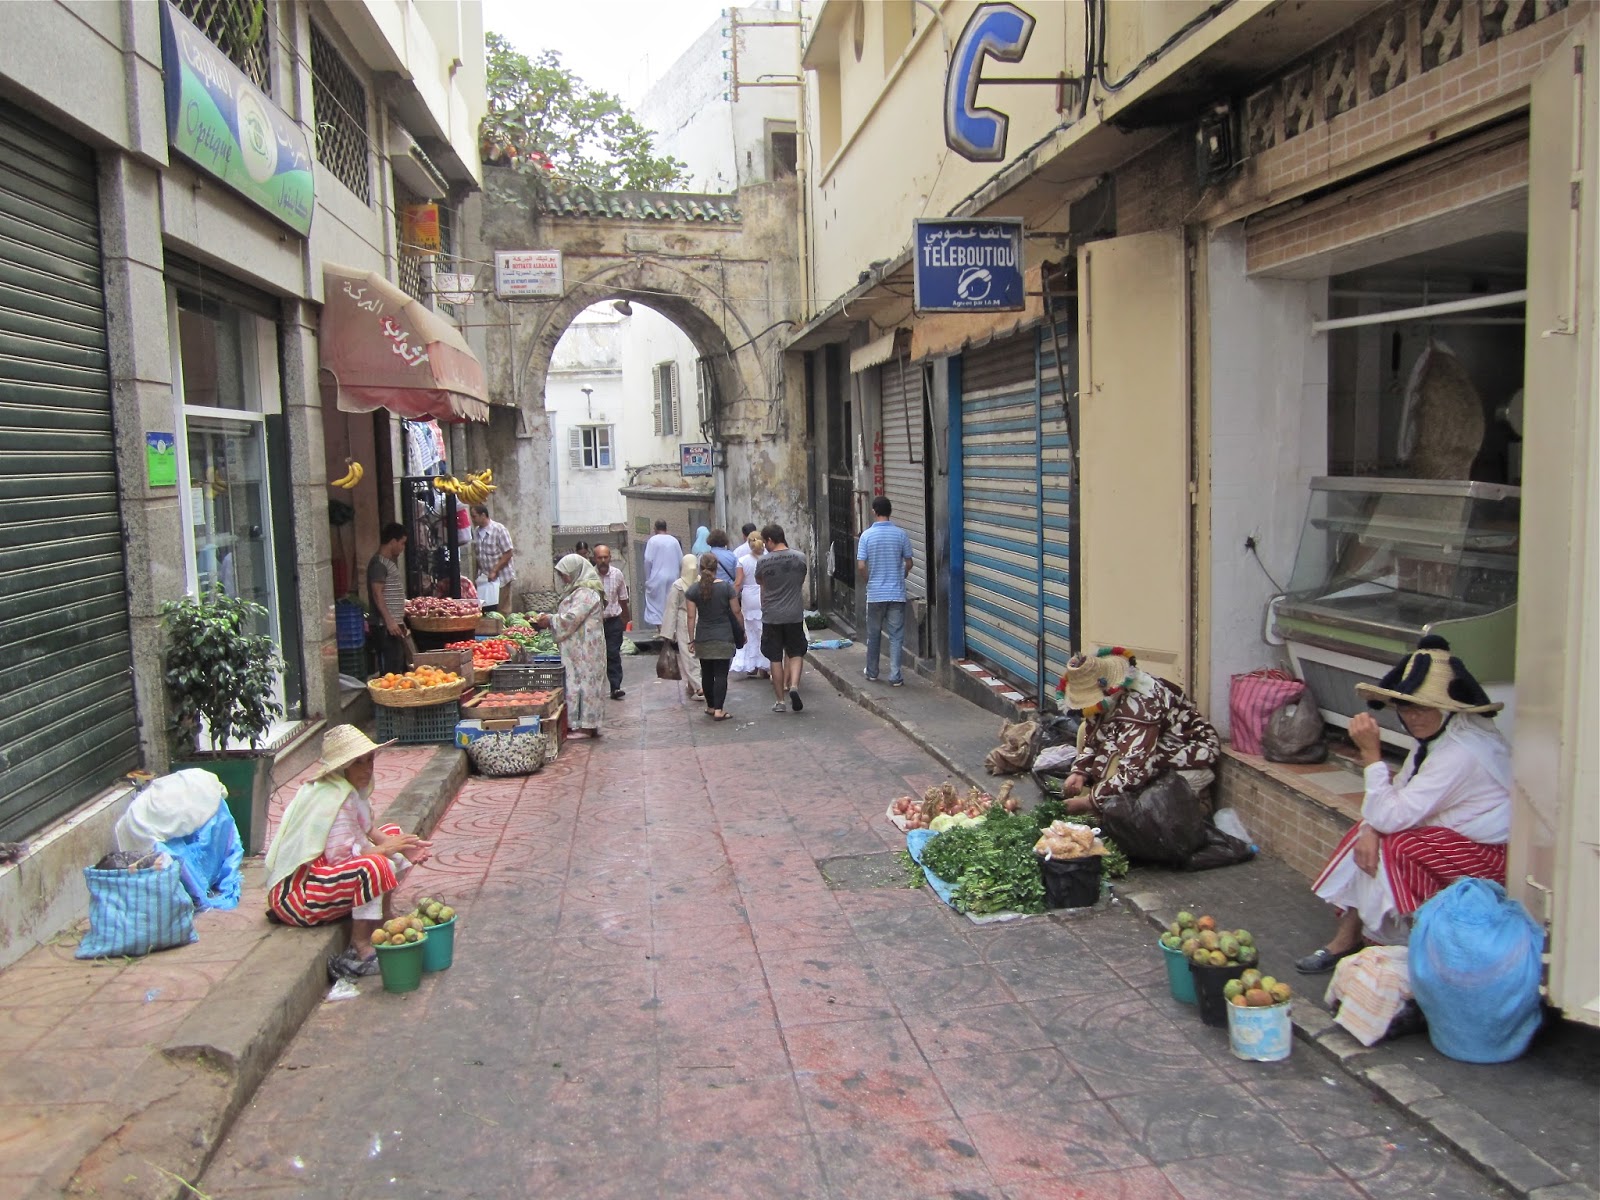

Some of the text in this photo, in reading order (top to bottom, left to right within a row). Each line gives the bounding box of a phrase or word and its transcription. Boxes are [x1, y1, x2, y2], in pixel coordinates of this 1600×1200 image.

[181, 31, 234, 99] Capitol
[186, 99, 233, 165] Optique
[923, 246, 1015, 267] TELEBOUTIQU
[925, 225, 1012, 247] اتف عمومي
[342, 280, 384, 316] البركة
[873, 431, 883, 497] INTERN
